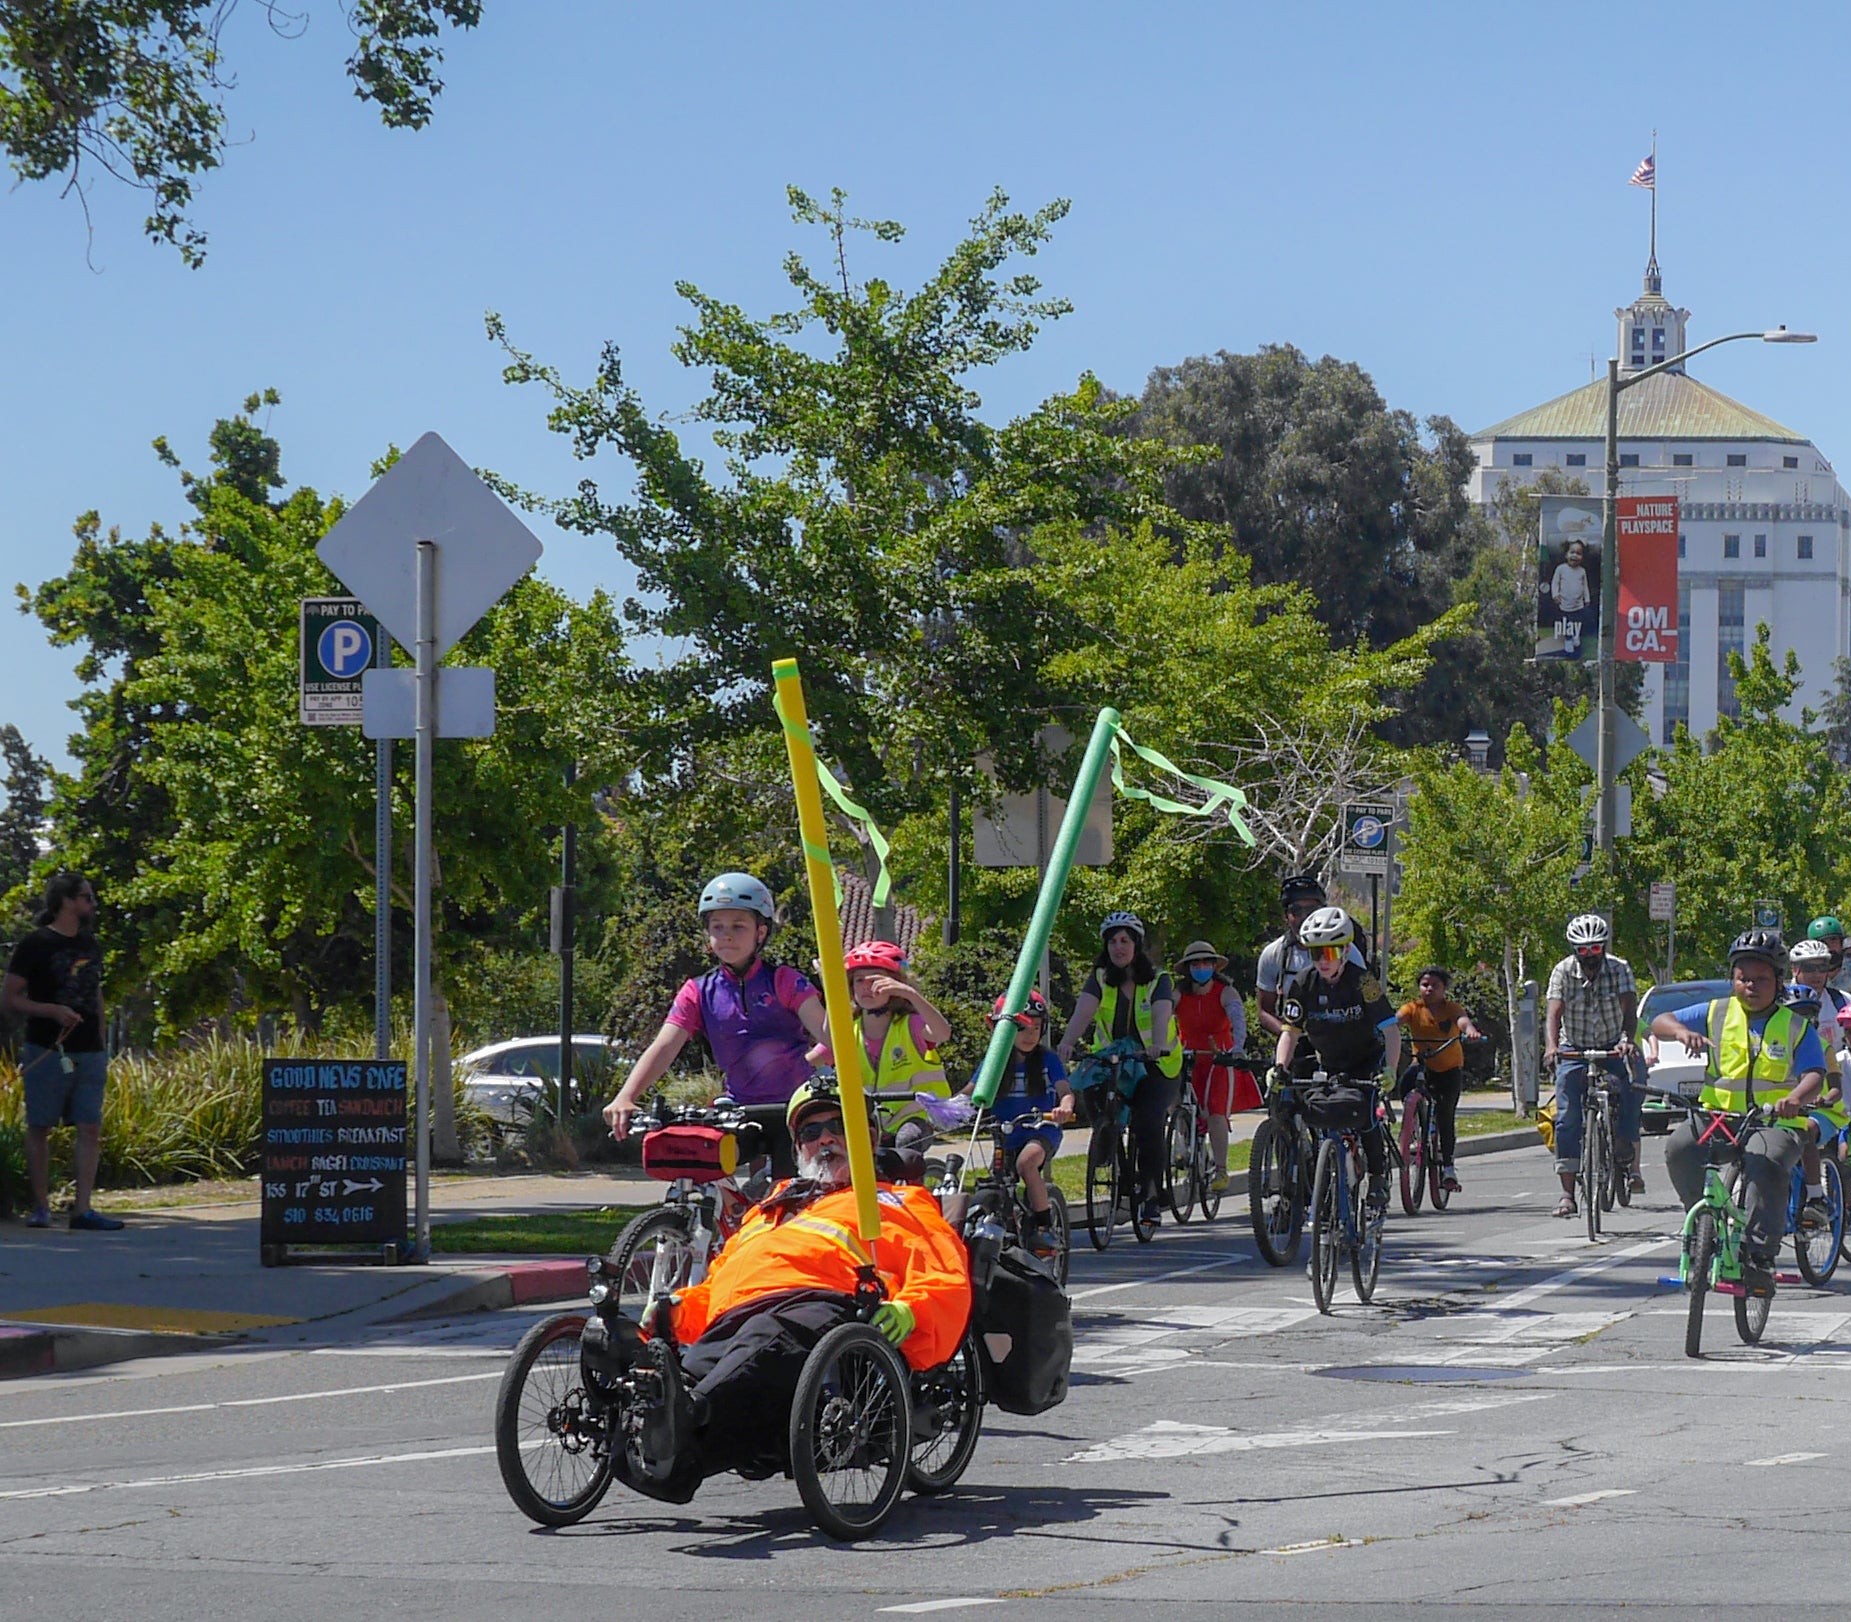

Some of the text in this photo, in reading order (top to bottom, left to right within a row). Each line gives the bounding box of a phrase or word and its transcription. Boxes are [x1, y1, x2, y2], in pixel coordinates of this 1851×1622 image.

[1636, 503, 1674, 518] NATURE
[1621, 519, 1674, 535] PLAYSPACE
[321, 604, 372, 617] PAY TO PA
[1627, 606, 1668, 629] OM
[1554, 616, 1582, 640] play
[334, 628, 361, 671] P
[321, 682, 351, 692] LICENSE
[270, 1065, 316, 1090] GOOD
[318, 1064, 361, 1089] NEWS
[316, 1099, 337, 1116] TEA
[267, 1126, 406, 1145] SMOOTHIES BREAKFAST
[319, 1181, 339, 1198] ST
